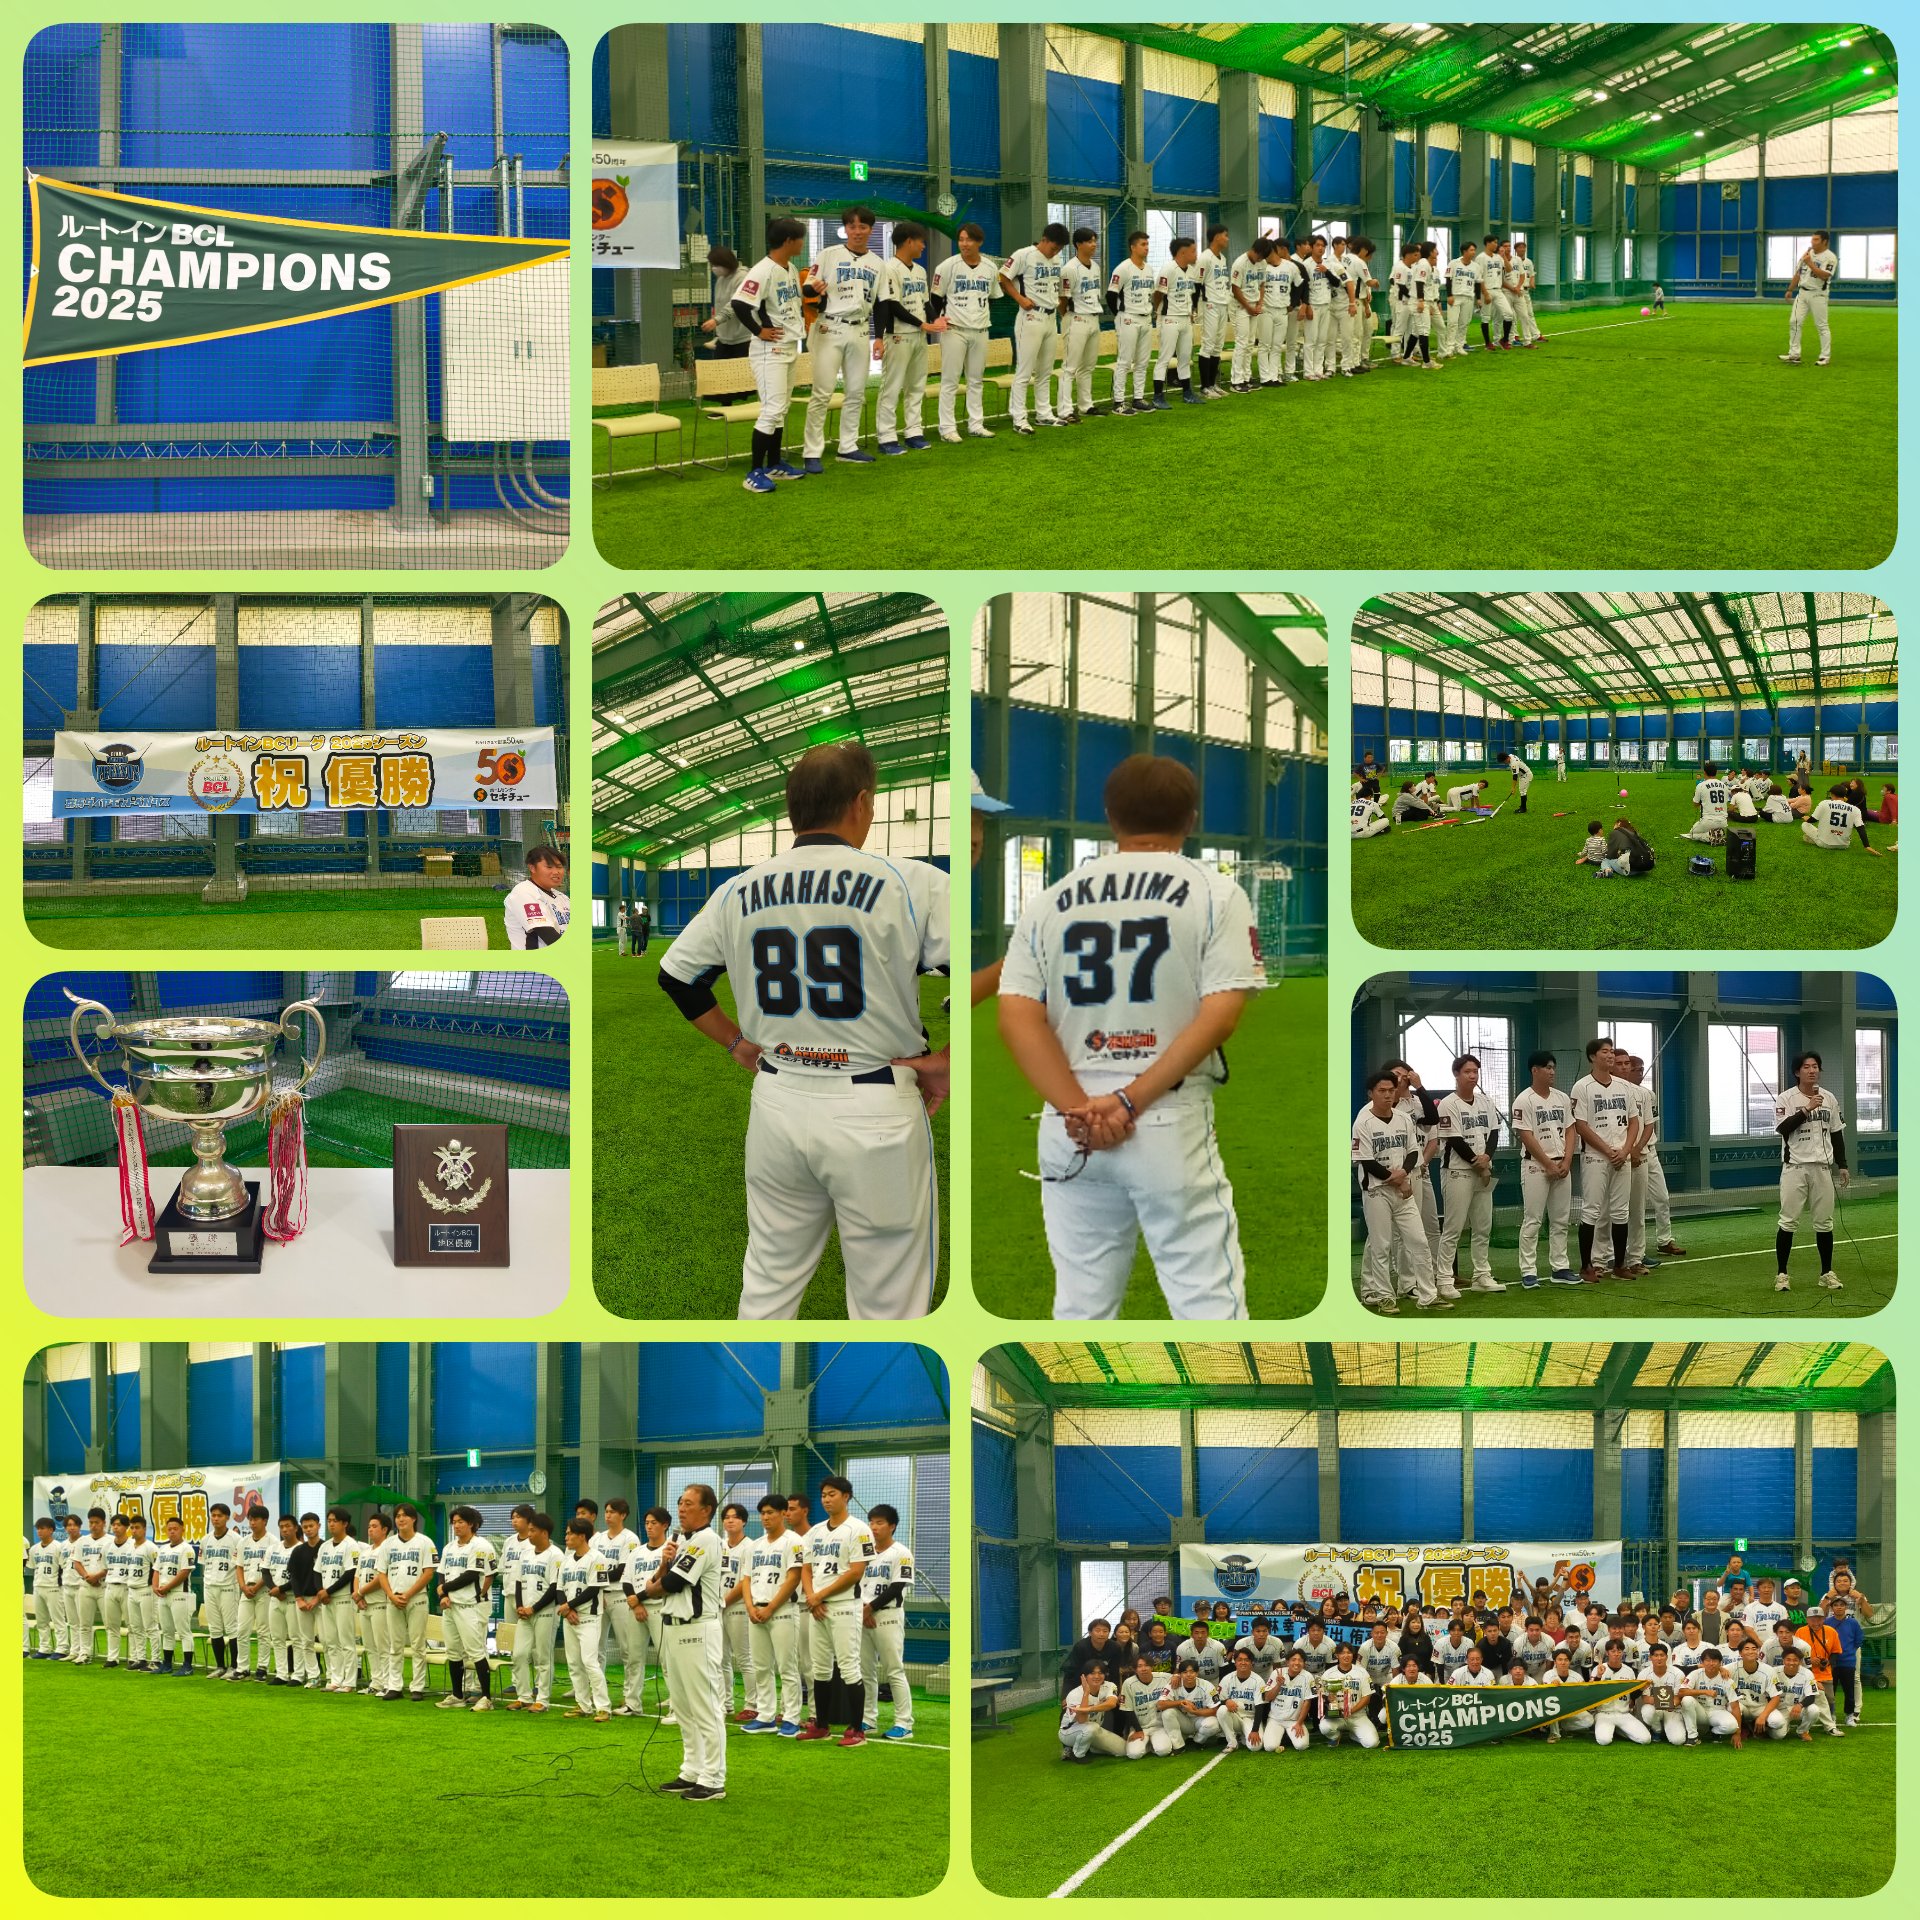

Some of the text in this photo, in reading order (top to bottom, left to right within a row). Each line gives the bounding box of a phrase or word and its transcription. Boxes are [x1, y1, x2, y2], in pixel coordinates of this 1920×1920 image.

[57, 214, 235, 247] ルートイン BCL
[57, 243, 392, 292] CHAMPIONS
[51, 285, 164, 323] 2025
[195, 733, 428, 752] ルートインBCリーグ 2025シーズン
[202, 781, 231, 793] BCL
[250, 752, 436, 812] 祝 優勝
[490, 792, 530, 802] セキチュー
[1710, 790, 1725, 804] 66
[1830, 812, 1848, 828] 51
[737, 869, 885, 918] TAKAHASHI
[1056, 871, 1190, 913] OKAJIMA
[1063, 916, 1171, 1007] 37
[751, 925, 866, 1021] 89
[1616, 1115, 1628, 1127] 24
[150, 1489, 210, 1544] 優勝
[1304, 1546, 1509, 1562] ルートインBCリーグ 2025シーズン
[119, 1568, 129, 1577] 34
[218, 1561, 229, 1571] 29
[407, 1566, 418, 1576] 12
[823, 1561, 839, 1575] 24
[133, 1569, 144, 1578] 20
[281, 1569, 291, 1580] 53
[331, 1569, 340, 1579] 31
[767, 1572, 780, 1585] 27
[536, 1580, 543, 1591] 5
[723, 1576, 736, 1589] 25
[1353, 1563, 1516, 1612] 祝 優勝
[1311, 1588, 1335, 1599] BCL
[1241, 1620, 1249, 1633] 6
[1292, 1700, 1298, 1709] 6
[1397, 1692, 1482, 1712] ルートイン BCL
[1713, 1697, 1722, 1706] 13
[1398, 1695, 1561, 1733] CHAMPIONS
[1401, 1729, 1454, 1747] 2025
